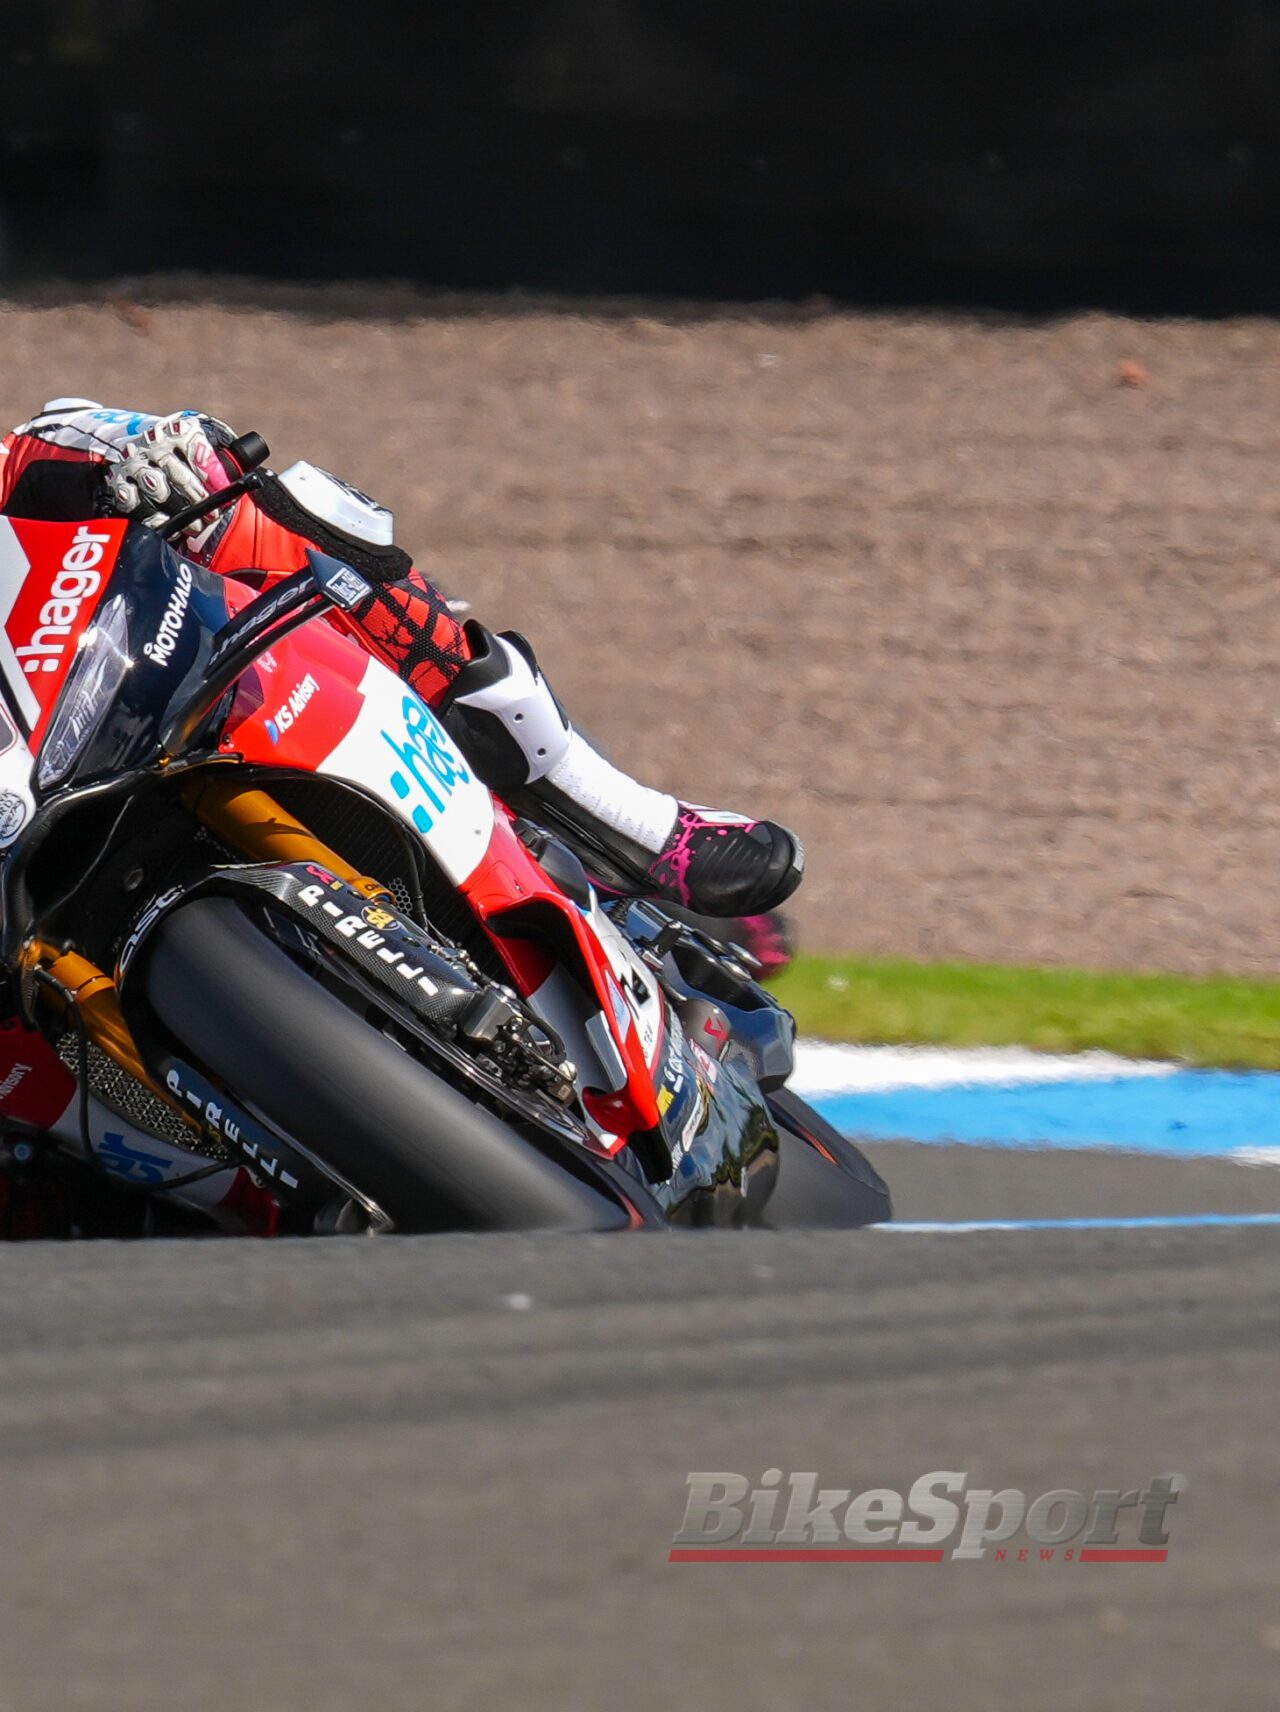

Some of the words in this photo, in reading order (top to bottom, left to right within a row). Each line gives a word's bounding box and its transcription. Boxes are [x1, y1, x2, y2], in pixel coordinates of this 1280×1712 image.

[144, 563, 192, 667] MOTOHALO
[274, 704, 294, 734] KS
[287, 673, 321, 721] Advisory
[297, 884, 439, 997] PIRELLI
[166, 1068, 299, 1189] PIRELLI
